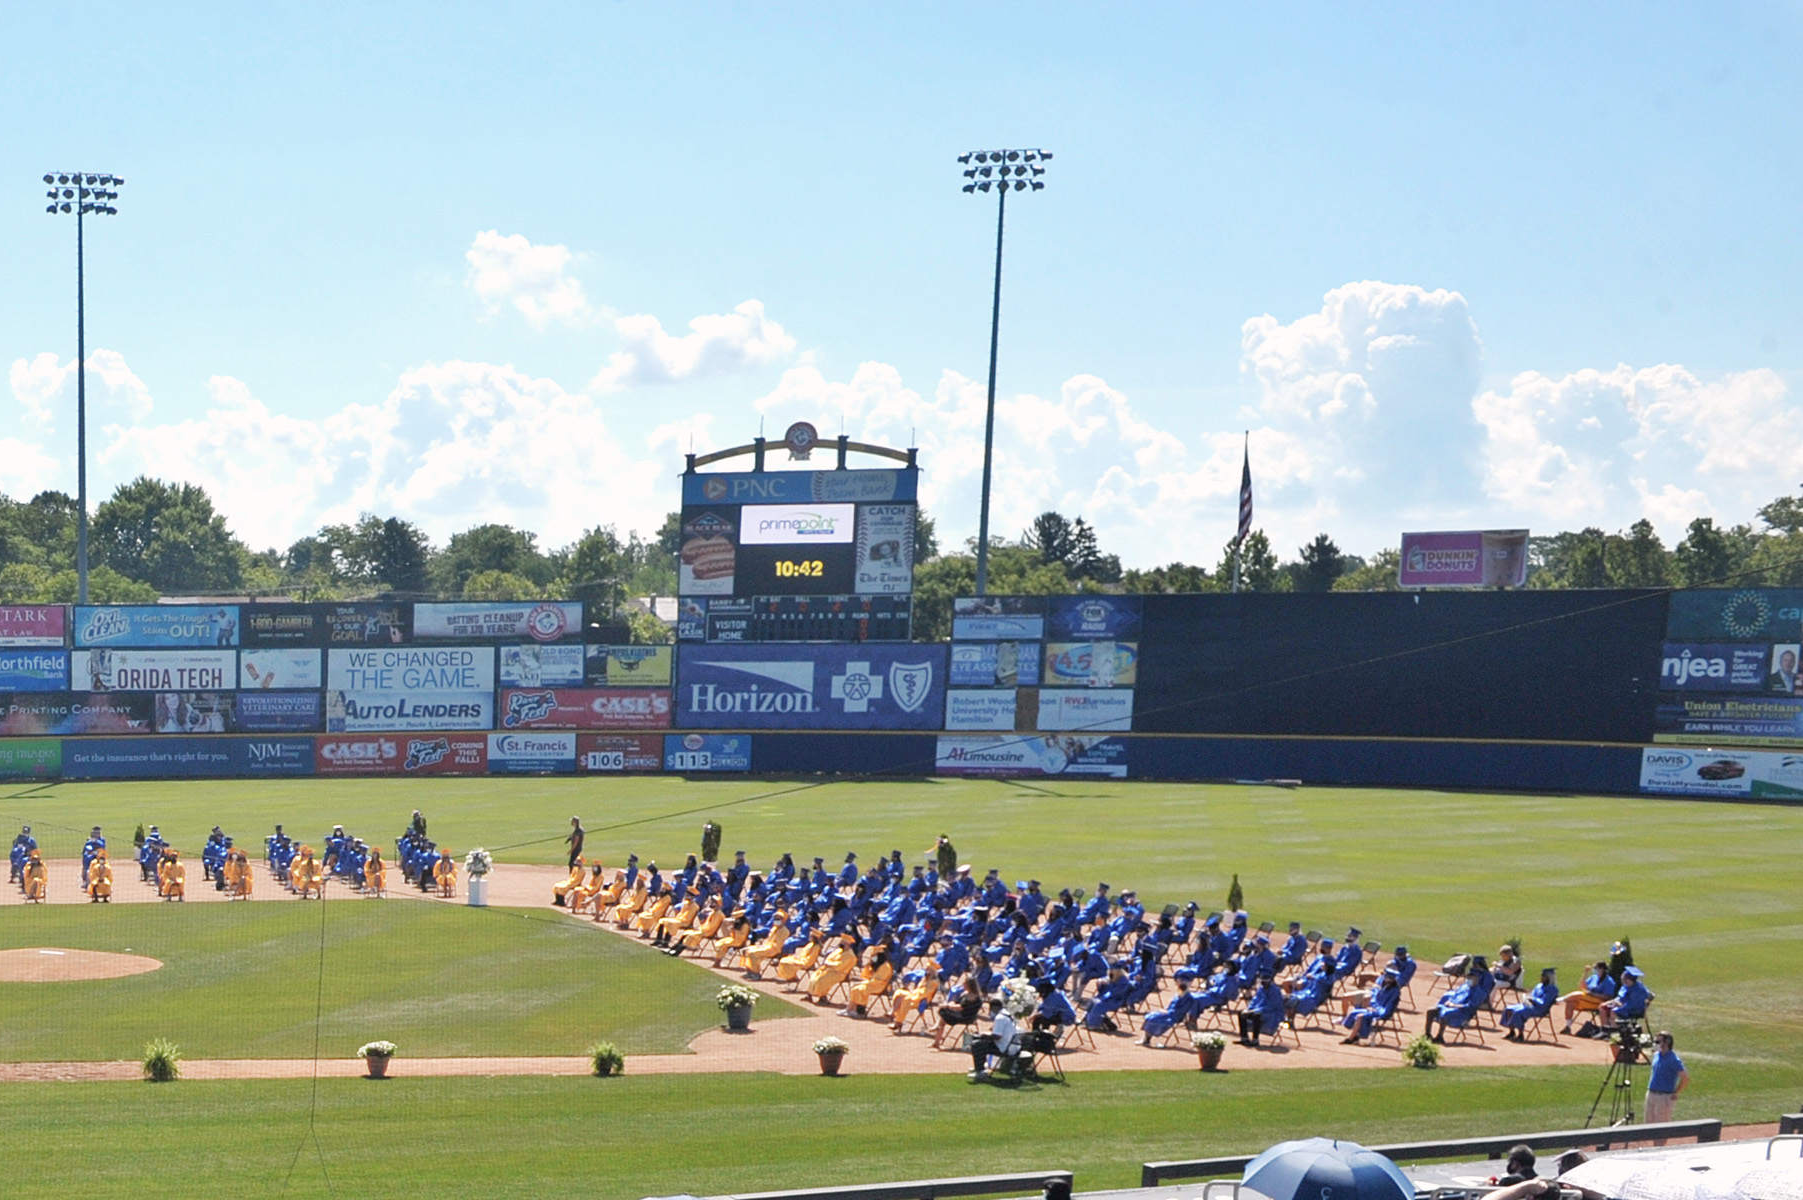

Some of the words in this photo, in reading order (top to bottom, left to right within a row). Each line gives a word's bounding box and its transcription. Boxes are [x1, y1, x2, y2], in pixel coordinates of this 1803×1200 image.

[733, 478, 786, 498] PNC
[868, 507, 906, 516] CATCH
[759, 516, 835, 533] primepoint
[775, 560, 824, 577] 10:42
[1426, 560, 1475, 570] DONUTS
[859, 573, 878, 583] The
[880, 573, 908, 583] Times
[447, 615, 480, 625] BATTING
[483, 612, 524, 624] CLEANUP
[715, 620, 747, 629] VISITOR
[169, 625, 210, 638] OUT!
[453, 625, 468, 634] FOR
[486, 624, 516, 634] YEARS
[349, 652, 377, 667] WE
[383, 651, 473, 667] CHANGED
[952, 662, 971, 672] EYE
[1662, 650, 1726, 685] njea
[43, 671, 64, 679] Bank
[111, 668, 172, 689] ORIDA
[177, 668, 223, 689] TECH
[346, 669, 393, 689] THE
[403, 668, 481, 689] GAME.
[689, 684, 815, 713] Horizon
[1684, 701, 1721, 711] Union
[1725, 701, 1801, 712] Electricians
[1685, 723, 1711, 731] EARN
[1712, 723, 1741, 731] WHILE
[321, 738, 398, 759] CASE'S
[507, 740, 522, 750] St.
[524, 740, 568, 750] Francis
[74, 754, 89, 763] Get
[91, 753, 105, 762] the
[106, 753, 147, 761] insurance
[174, 752, 195, 763] right
[197, 752, 210, 761] for
[248, 744, 282, 761] NJM
